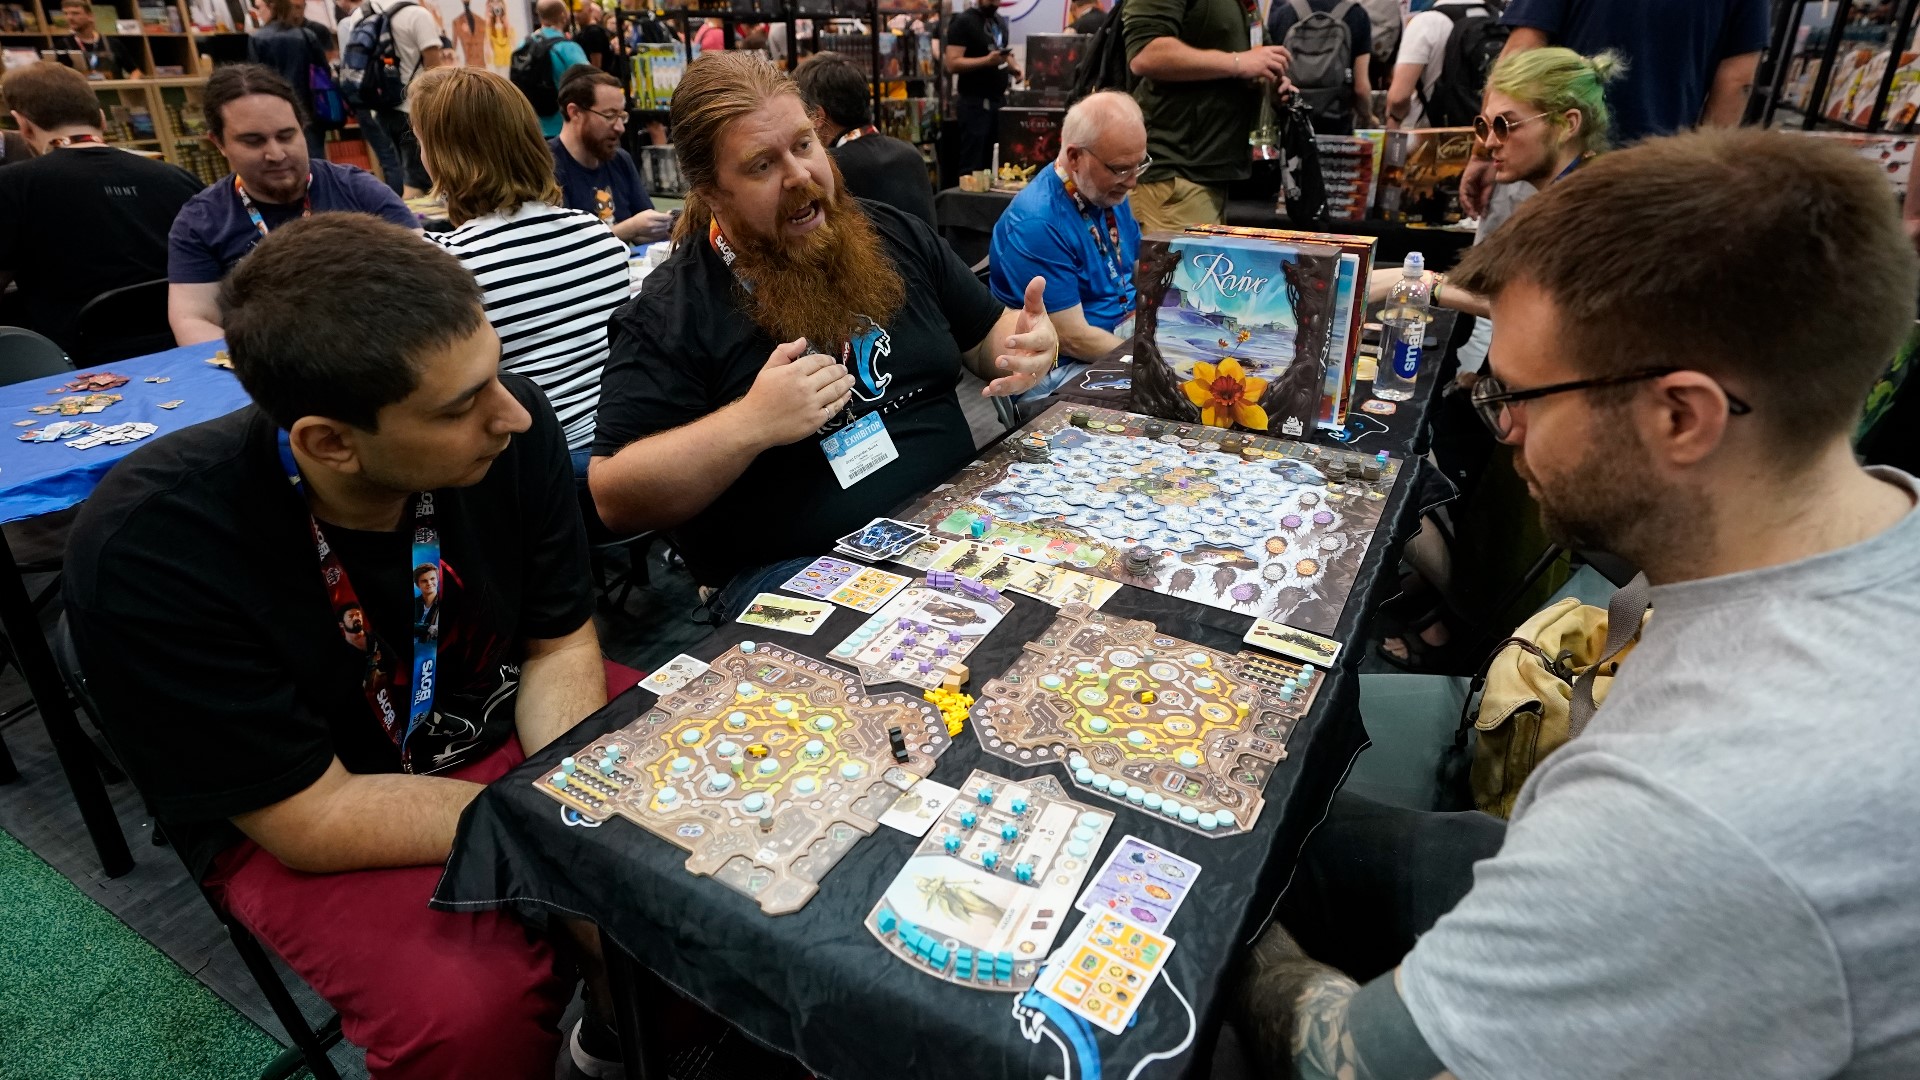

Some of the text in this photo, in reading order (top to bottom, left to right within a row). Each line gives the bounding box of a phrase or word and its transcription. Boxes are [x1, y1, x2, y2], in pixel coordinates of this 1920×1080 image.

[714, 235, 737, 262] BOYS
[1192, 252, 1269, 298] Revive
[1403, 320, 1424, 372] smart
[844, 421, 882, 447] EXHIBITOR
[415, 501, 423, 519] THE
[419, 659, 434, 701] BOYS
[376, 688, 397, 725] BOYS
